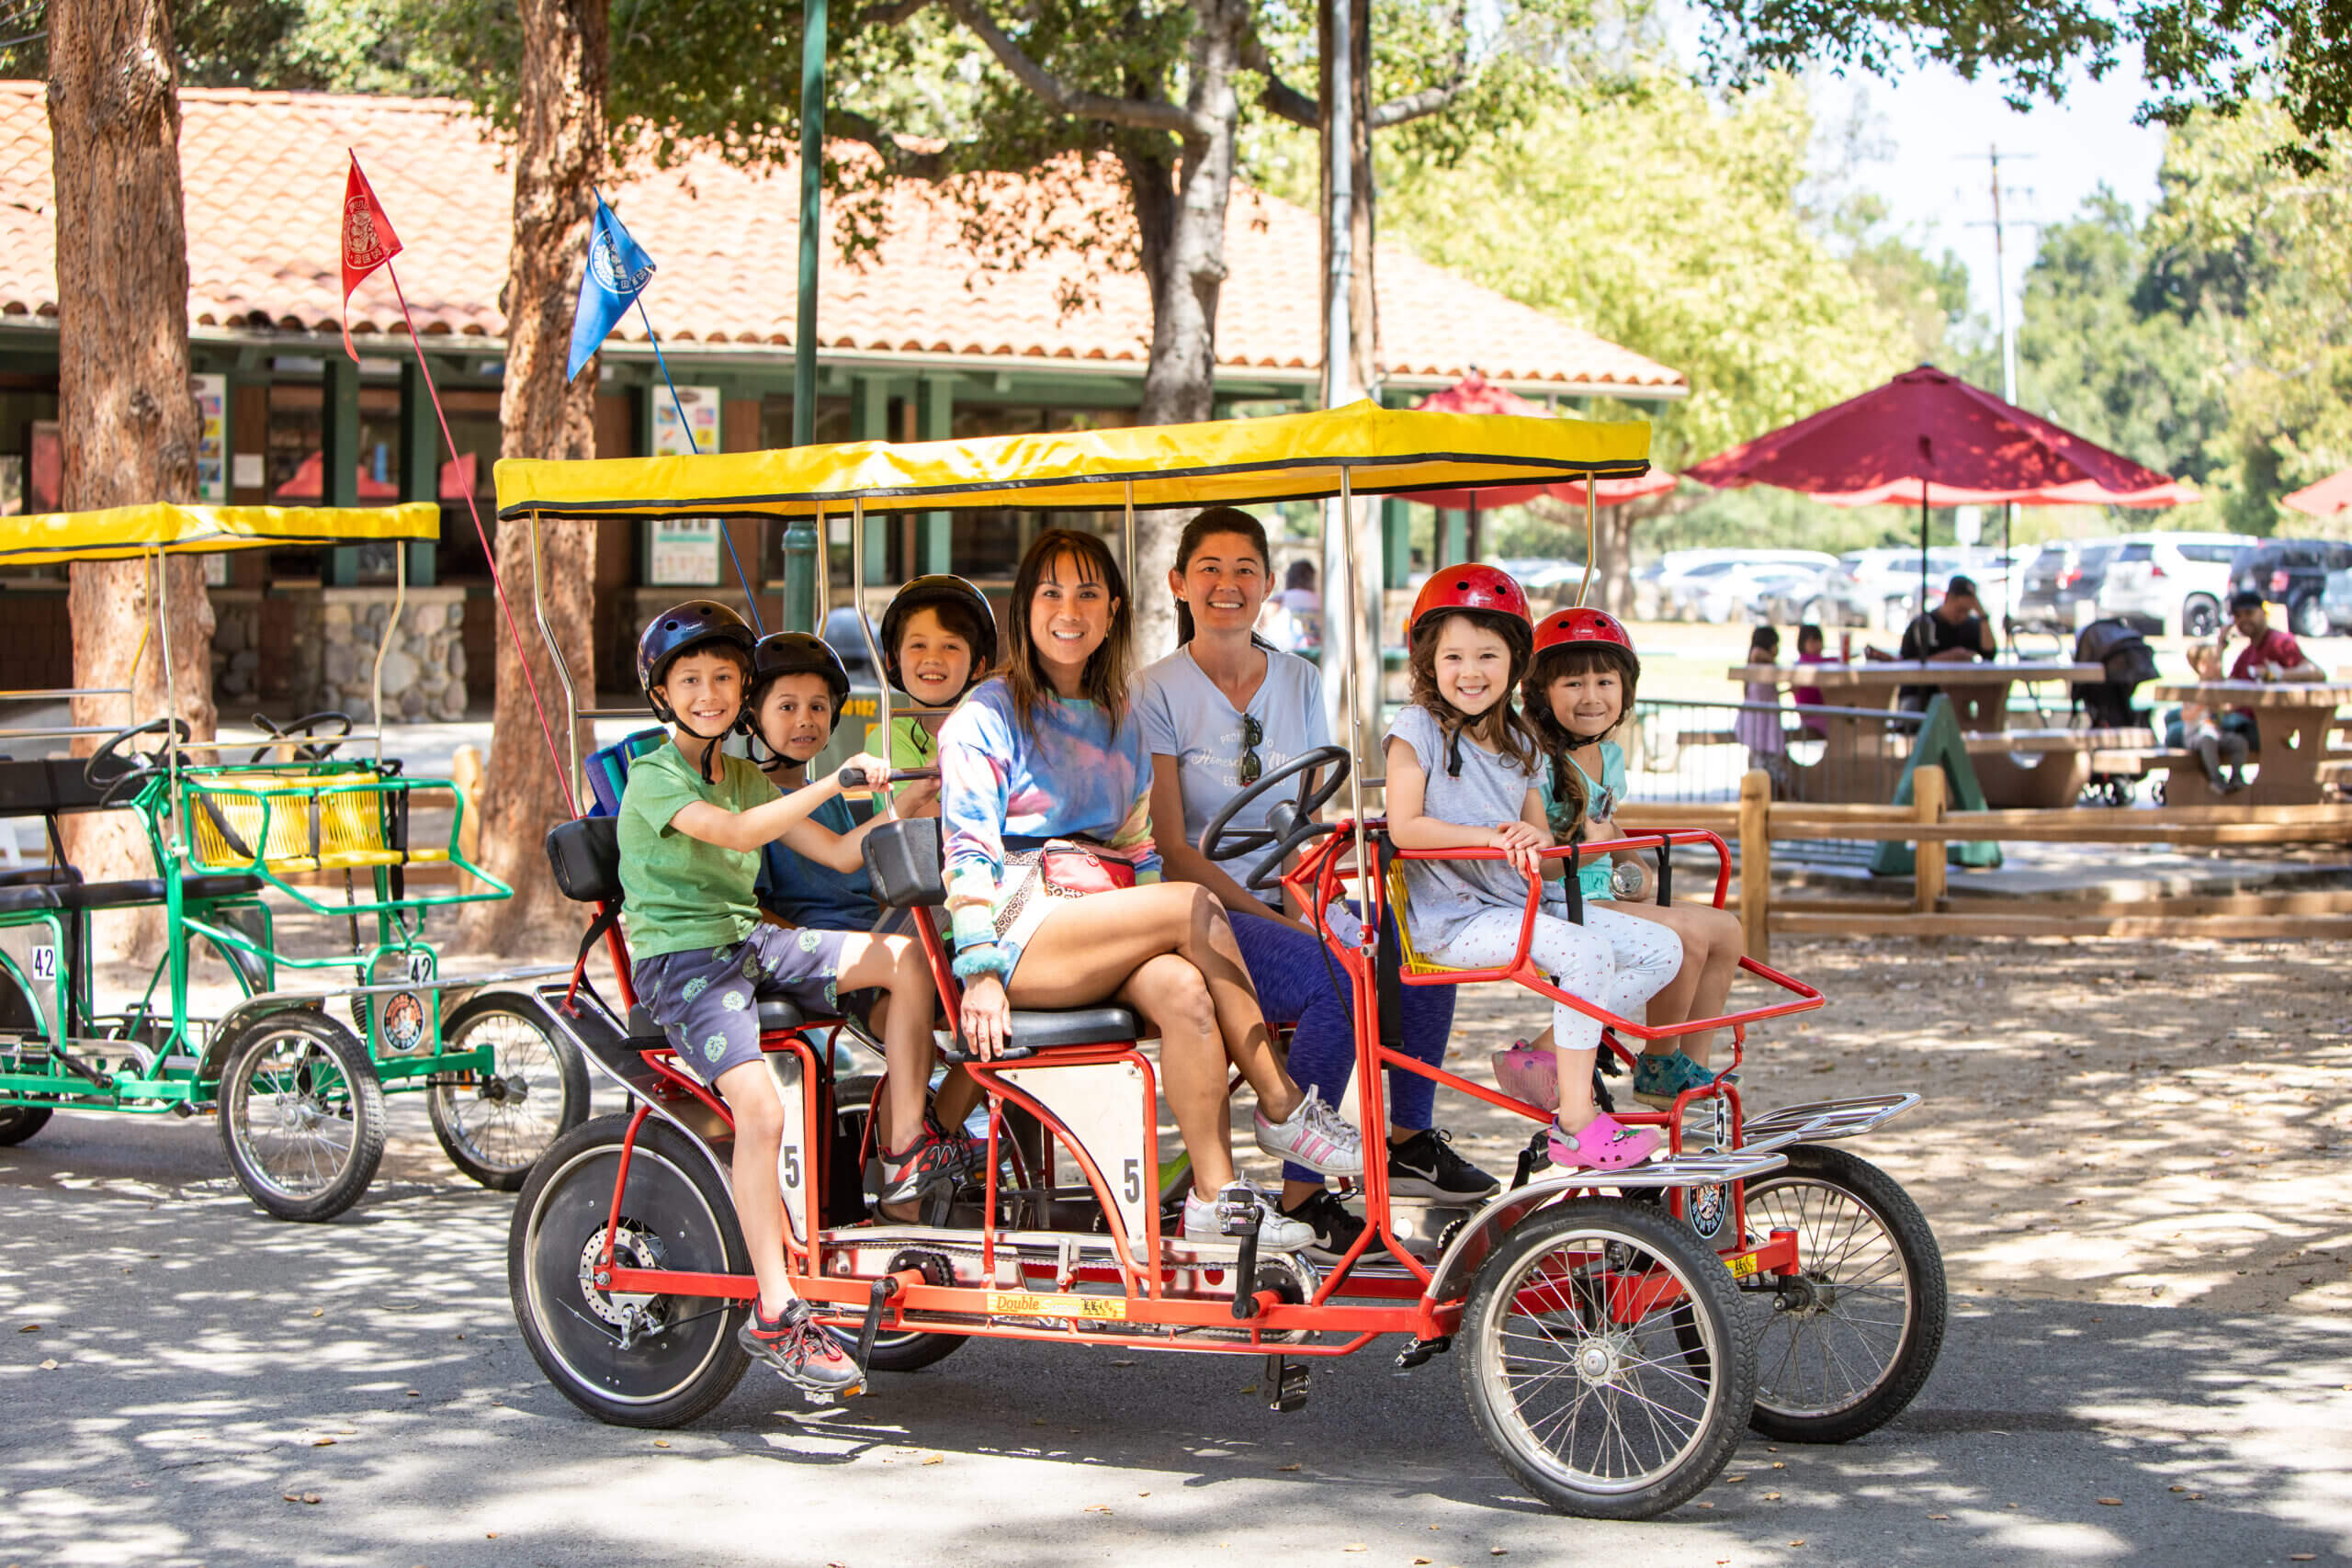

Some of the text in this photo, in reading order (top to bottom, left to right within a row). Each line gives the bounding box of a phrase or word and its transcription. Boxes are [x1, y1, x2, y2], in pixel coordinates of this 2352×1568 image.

[35, 948, 55, 977] 42
[411, 957, 432, 983] 42
[1716, 1099, 1725, 1145] 5
[783, 1145, 800, 1189] 5
[1124, 1159, 1139, 1203] 5
[996, 1295, 1040, 1312] Double
